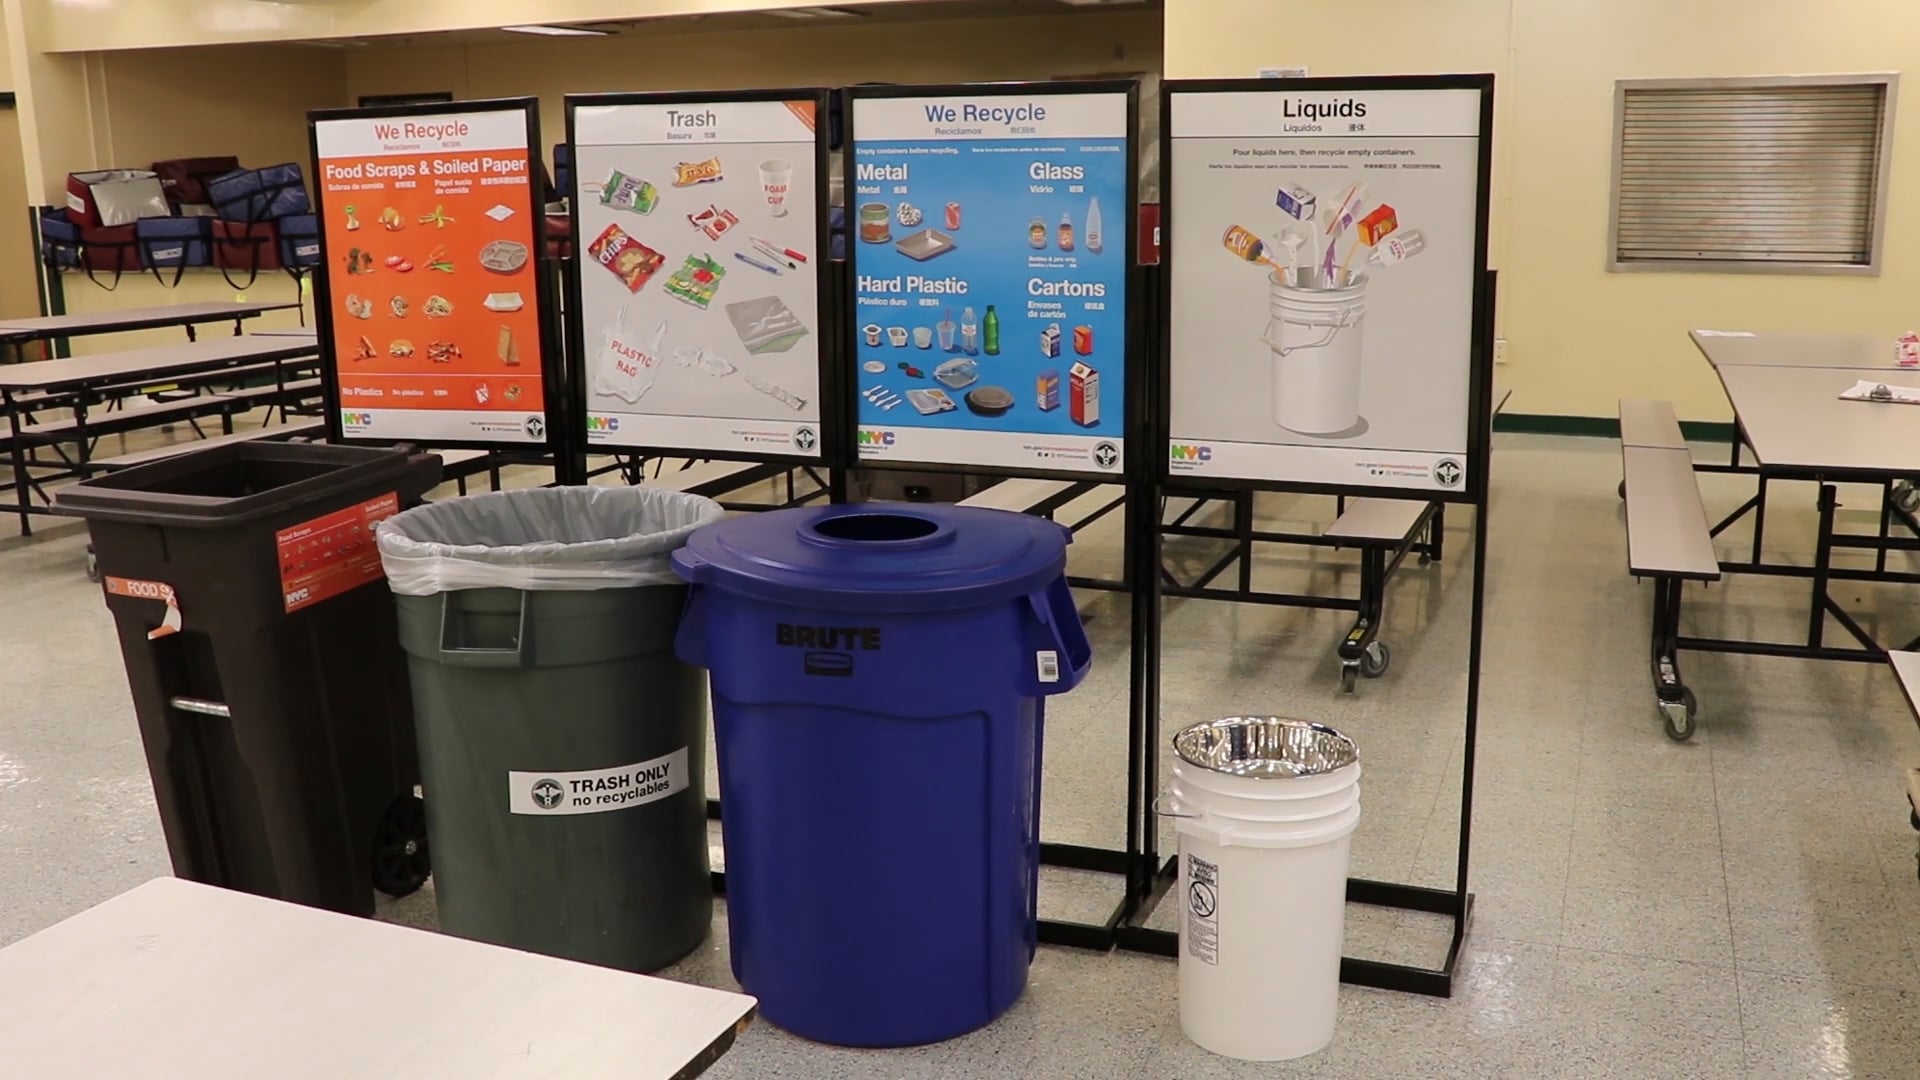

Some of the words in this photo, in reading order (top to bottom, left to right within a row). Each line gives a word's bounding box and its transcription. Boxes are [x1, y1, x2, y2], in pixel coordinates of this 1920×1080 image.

[924, 104, 957, 123] We
[963, 103, 1046, 125] Recycle
[1283, 98, 1367, 122] Liquids
[666, 110, 717, 128] Trash
[375, 124, 400, 140] We
[404, 120, 469, 141] Recycle
[666, 132, 693, 140] Basura
[934, 126, 982, 136] Reciclamos
[1283, 123, 1323, 134] Líquidos
[856, 147, 875, 156] Empty
[876, 147, 908, 155] containers
[909, 147, 929, 155] before
[1232, 148, 1251, 157] Pour
[1252, 147, 1277, 158] liquids
[1278, 148, 1298, 158] here,
[1299, 147, 1317, 156] then
[1318, 147, 1346, 158] recycle
[1347, 148, 1372, 158] empty
[1373, 147, 1417, 156] containers.
[326, 164, 362, 180] Food
[365, 161, 416, 179] Scraps
[418, 160, 431, 176] &
[433, 158, 479, 175] Soiled
[483, 157, 526, 175] Paper
[856, 163, 908, 181] Metal
[1029, 161, 1084, 180] Glass
[765, 184, 787, 194] FOAM
[857, 185, 881, 194] Metal
[1029, 185, 1055, 193] Vidrio
[768, 196, 784, 205] CUP
[599, 235, 628, 264] CHIPS
[857, 275, 901, 294] Hard
[906, 275, 968, 295] Plastic
[1028, 277, 1106, 297] Cartons
[889, 298, 908, 306] duro
[1028, 300, 1062, 310] Envases
[1027, 310, 1038, 319] de
[1039, 309, 1067, 319] cartón
[611, 340, 653, 368] PLASTIC
[616, 360, 638, 378] BAG
[342, 387, 353, 396] No
[354, 387, 384, 397] Plastics
[344, 413, 372, 426] NYC
[588, 417, 619, 431] NYC
[858, 431, 895, 446] NYC
[1171, 444, 1212, 461] NYC
[127, 581, 158, 597] FOOD
[286, 587, 309, 604] NYC
[776, 623, 881, 651] BRUTE
[569, 774, 630, 794] TRASH
[635, 762, 671, 783] ONLY
[572, 795, 592, 807] no
[596, 780, 670, 805] recyclables
